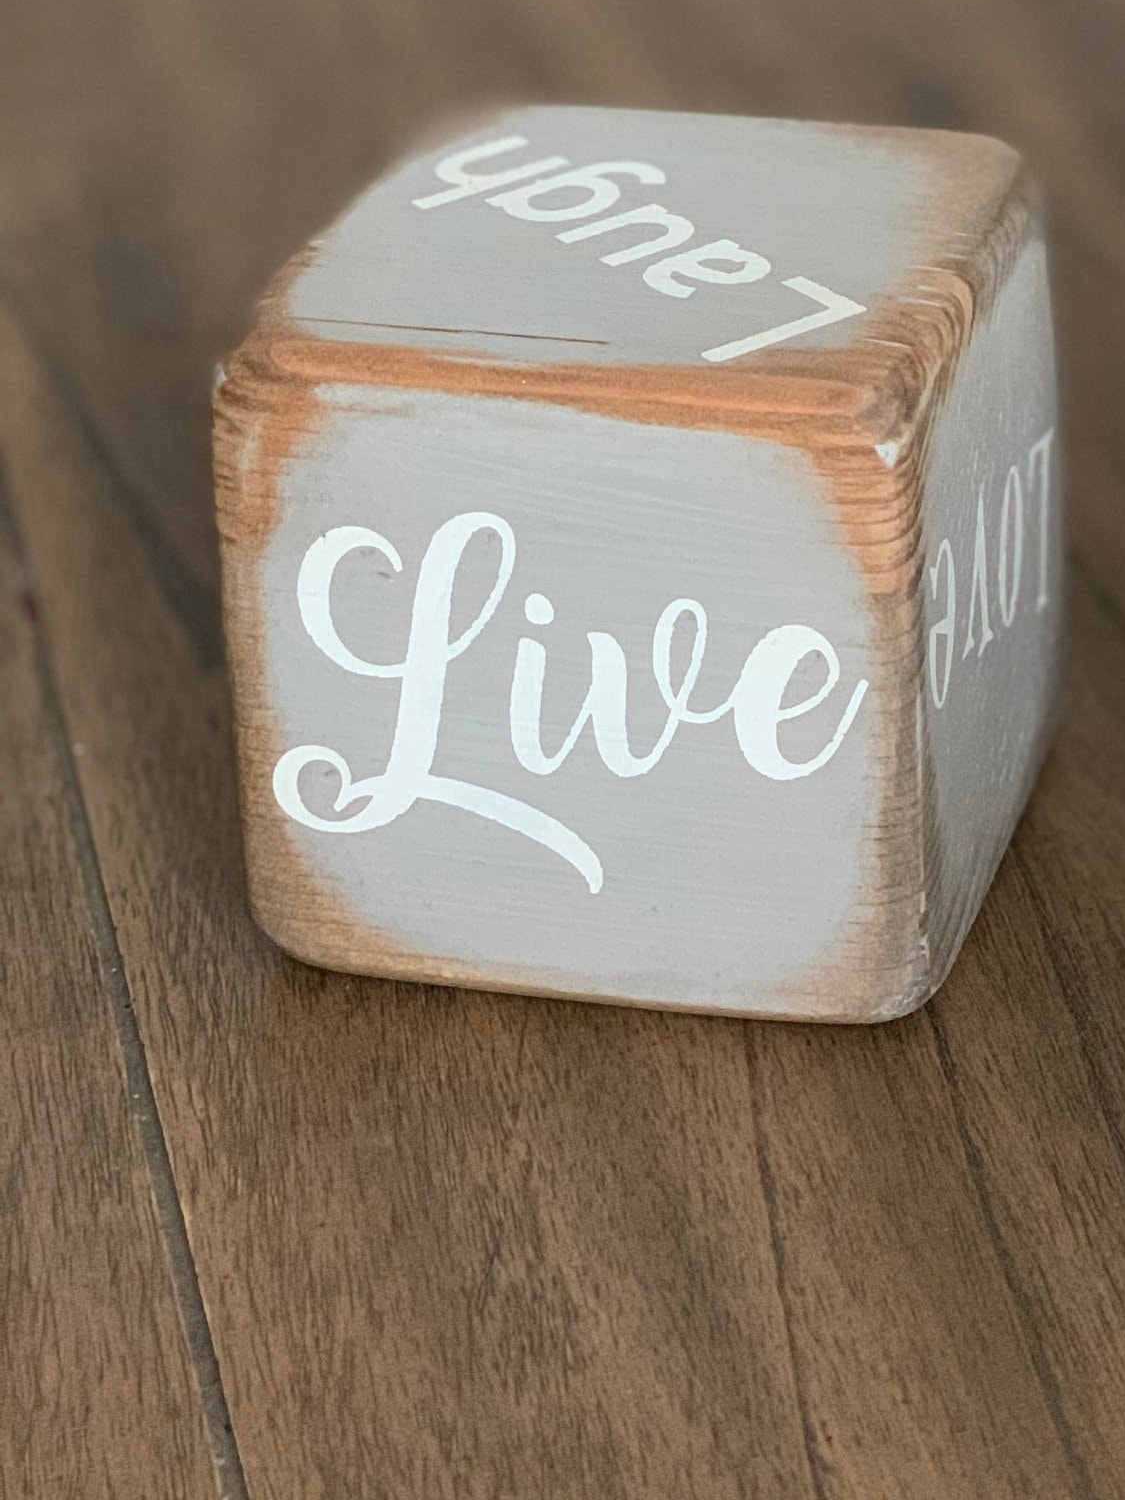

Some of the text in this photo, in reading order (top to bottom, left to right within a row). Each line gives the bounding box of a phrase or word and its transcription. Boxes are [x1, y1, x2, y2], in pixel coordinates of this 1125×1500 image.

[412, 135, 868, 363] Laugh
[272, 511, 868, 893] Live
[929, 427, 1055, 709] Love
